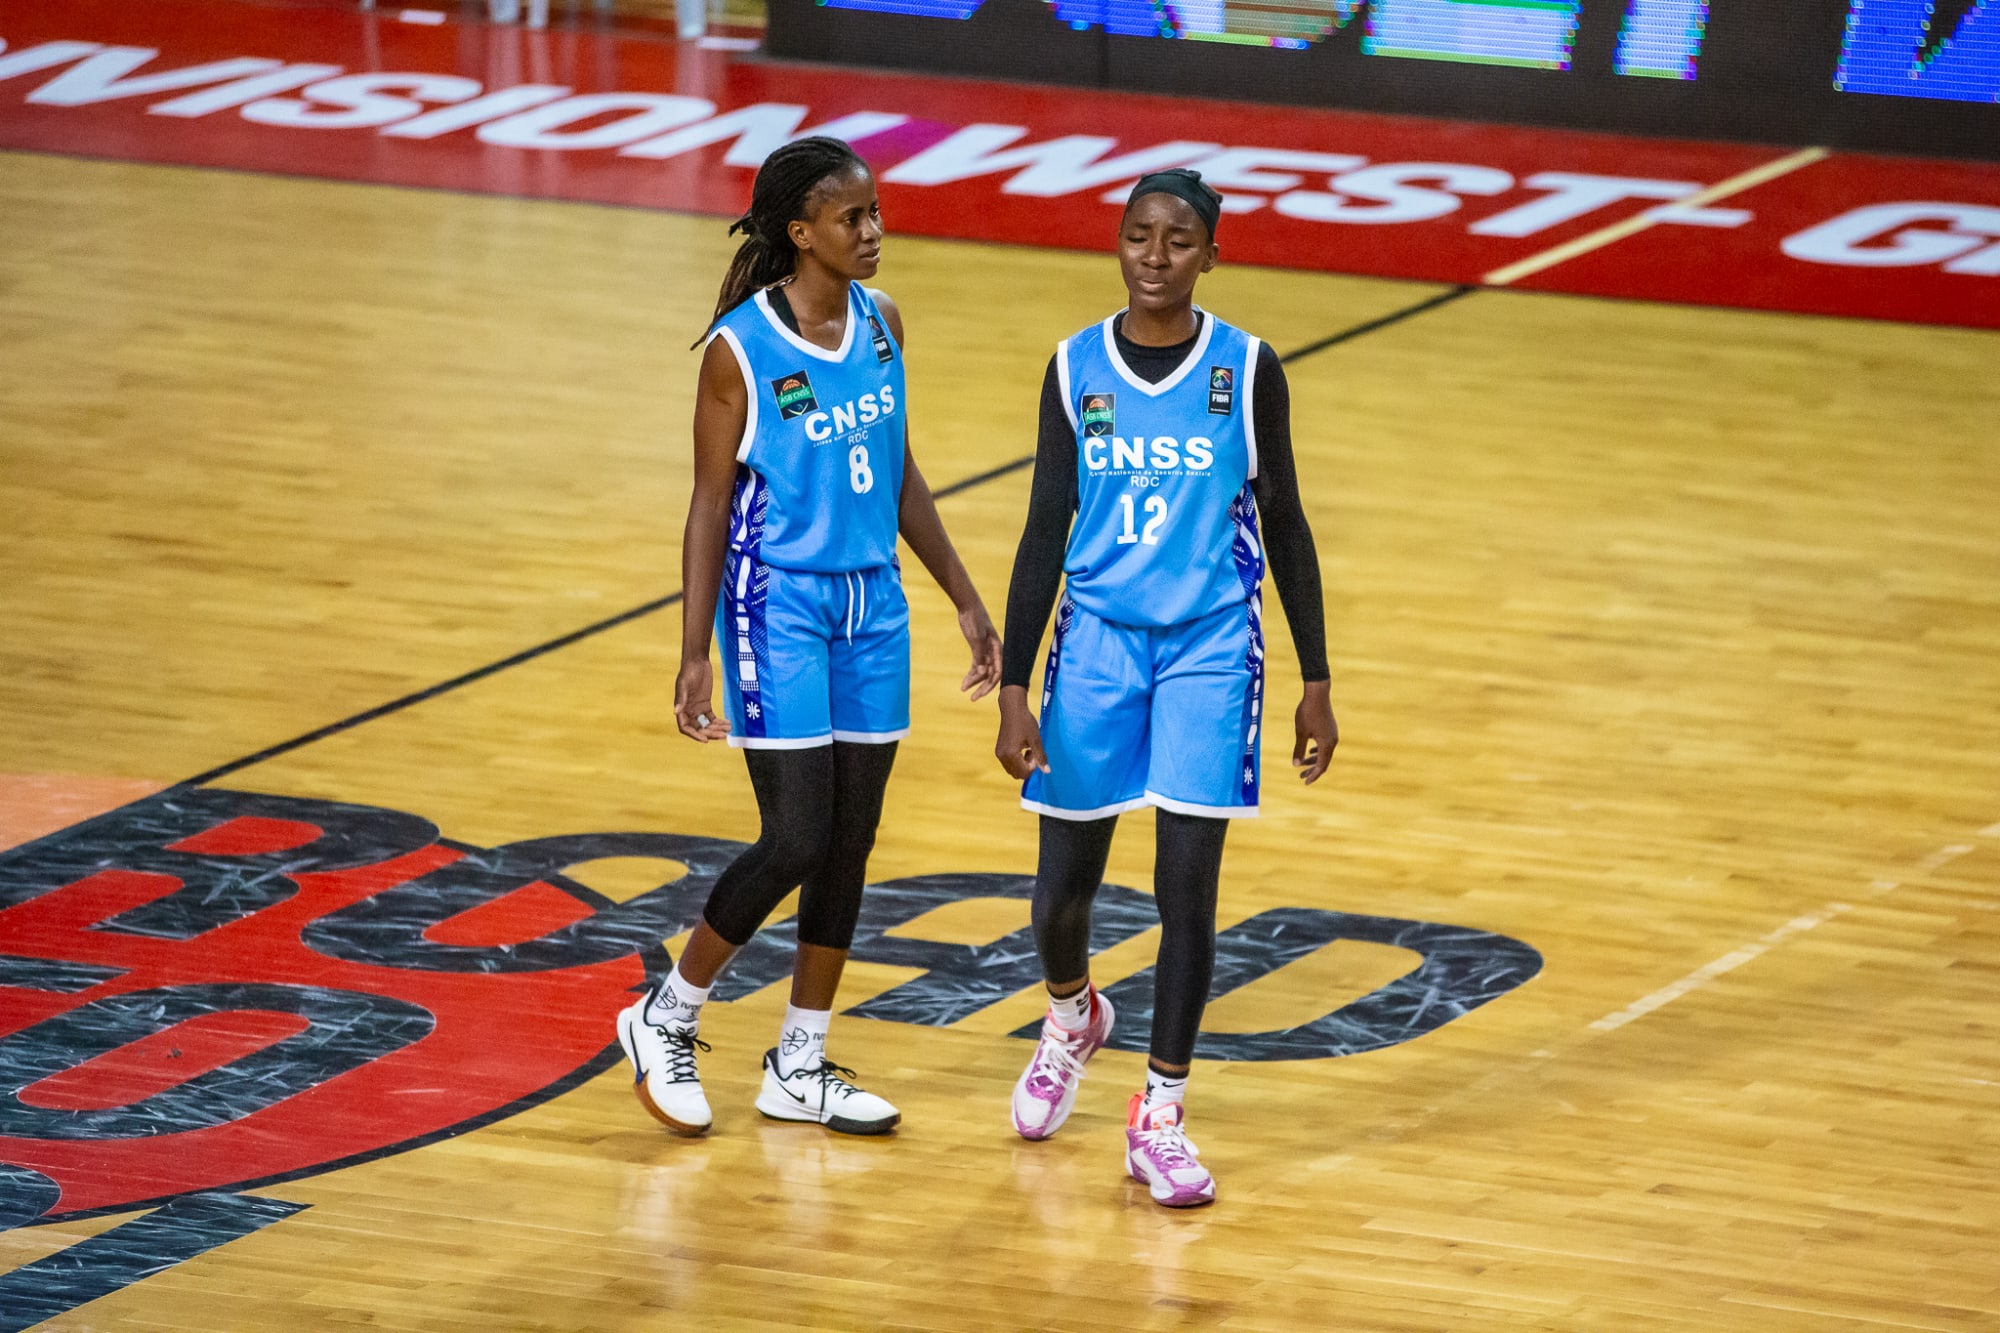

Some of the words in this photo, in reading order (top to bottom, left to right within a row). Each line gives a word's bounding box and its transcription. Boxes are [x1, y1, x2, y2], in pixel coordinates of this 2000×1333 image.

[805, 384, 895, 442] CNSS
[1212, 393, 1230, 403] FIBA
[847, 430, 869, 446] RDC
[1084, 436, 1214, 471] CNSS
[848, 444, 874, 495] 8
[1130, 475, 1160, 488] RDC
[1116, 494, 1168, 546] 12
